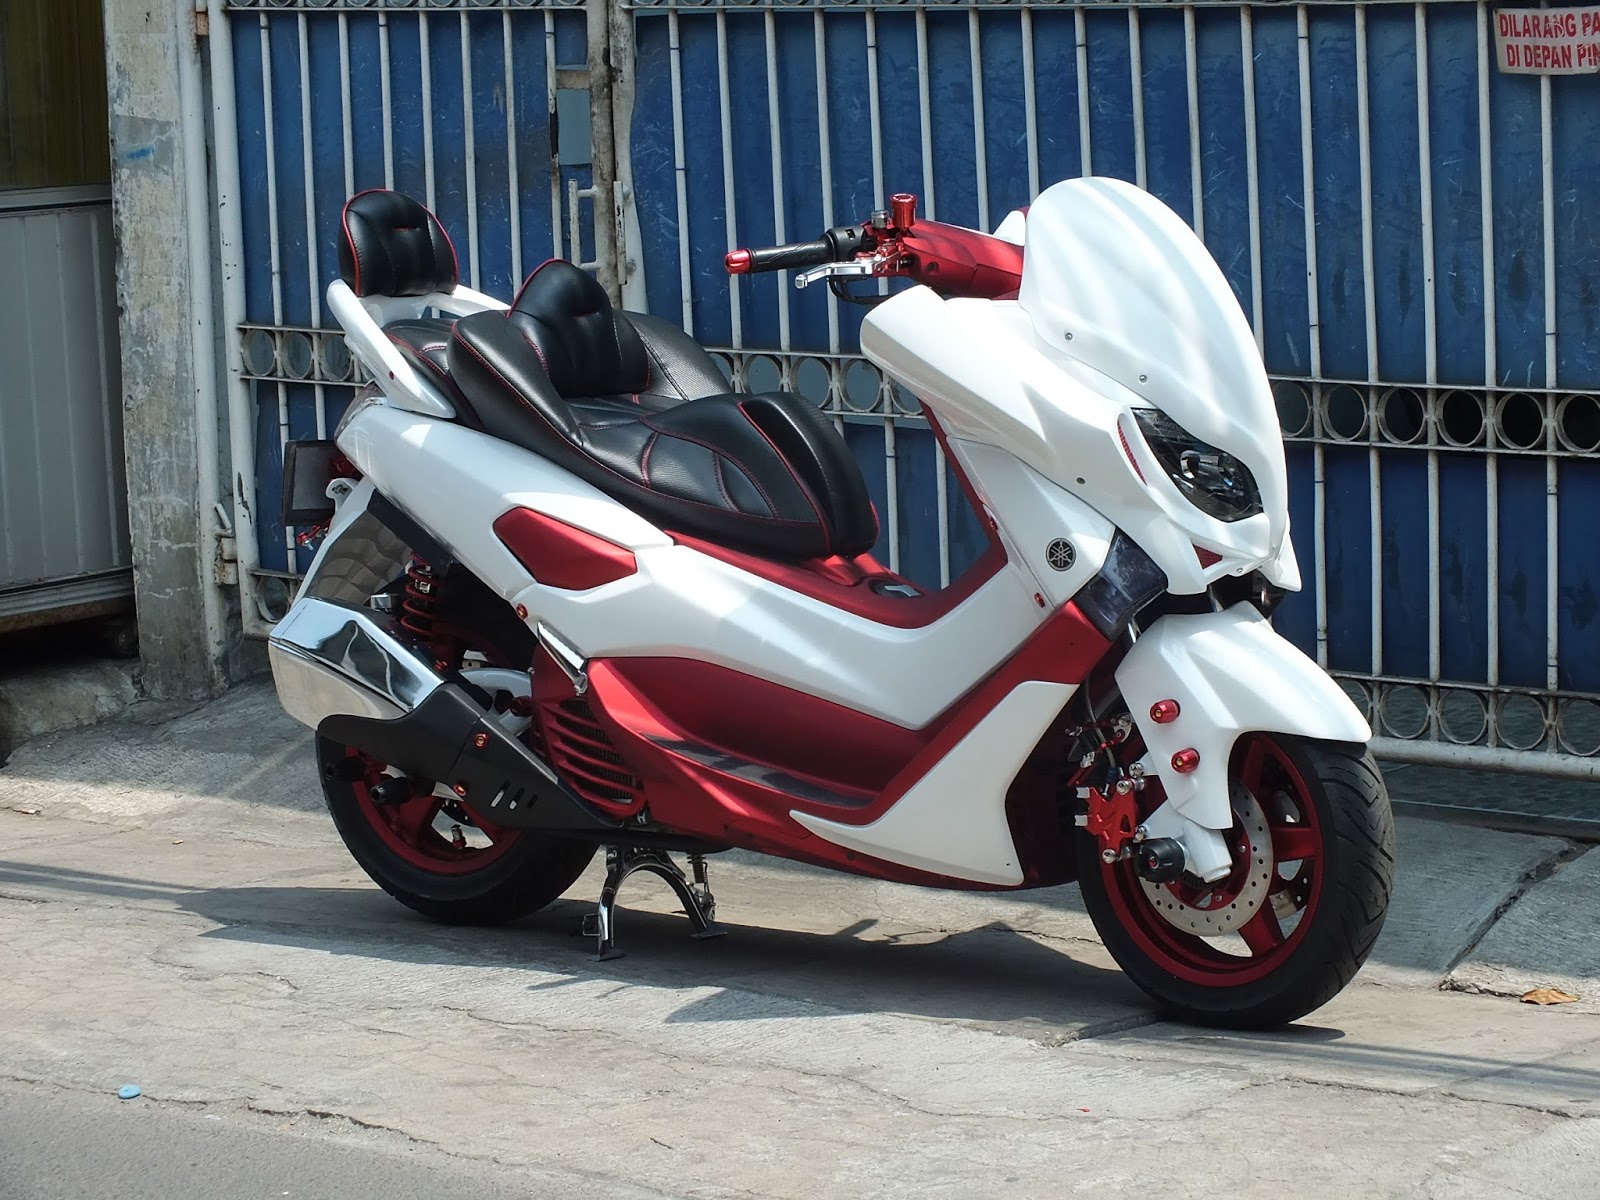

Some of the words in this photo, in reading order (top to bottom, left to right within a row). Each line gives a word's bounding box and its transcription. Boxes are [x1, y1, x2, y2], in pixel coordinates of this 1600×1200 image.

[1499, 13, 1577, 38] DILARANG
[1506, 44, 1520, 67] DI
[1524, 44, 1572, 68] DEPAN
